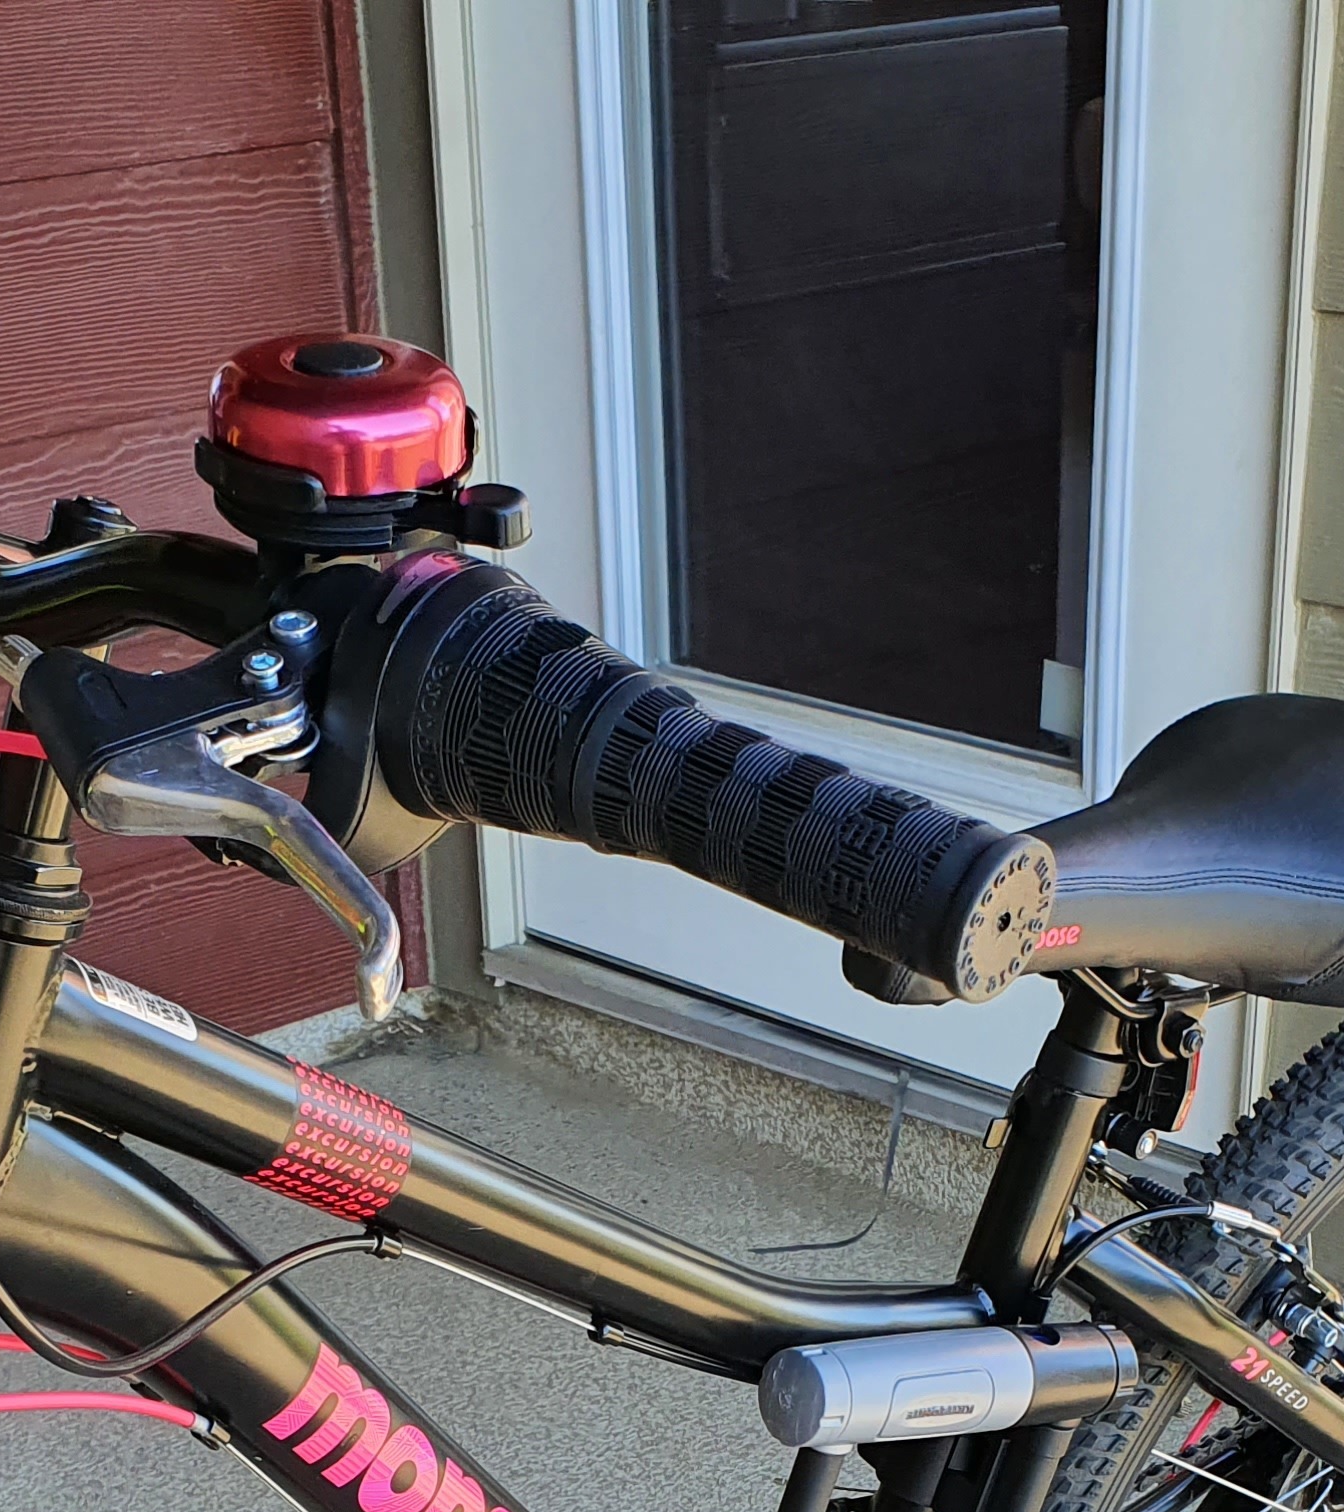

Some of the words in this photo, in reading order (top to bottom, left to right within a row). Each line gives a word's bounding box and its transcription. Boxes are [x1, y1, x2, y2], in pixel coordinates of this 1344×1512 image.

[300, 1083, 410, 1138] excursion
[300, 1101, 410, 1157] excursion
[285, 1141, 400, 1193] excursion
[294, 1121, 408, 1176] excursion
[257, 1169, 377, 1217] excursion
[271, 1157, 390, 1207] excursion
[1231, 1347, 1269, 1380] 21
[1260, 1369, 1308, 1409] SPEED
